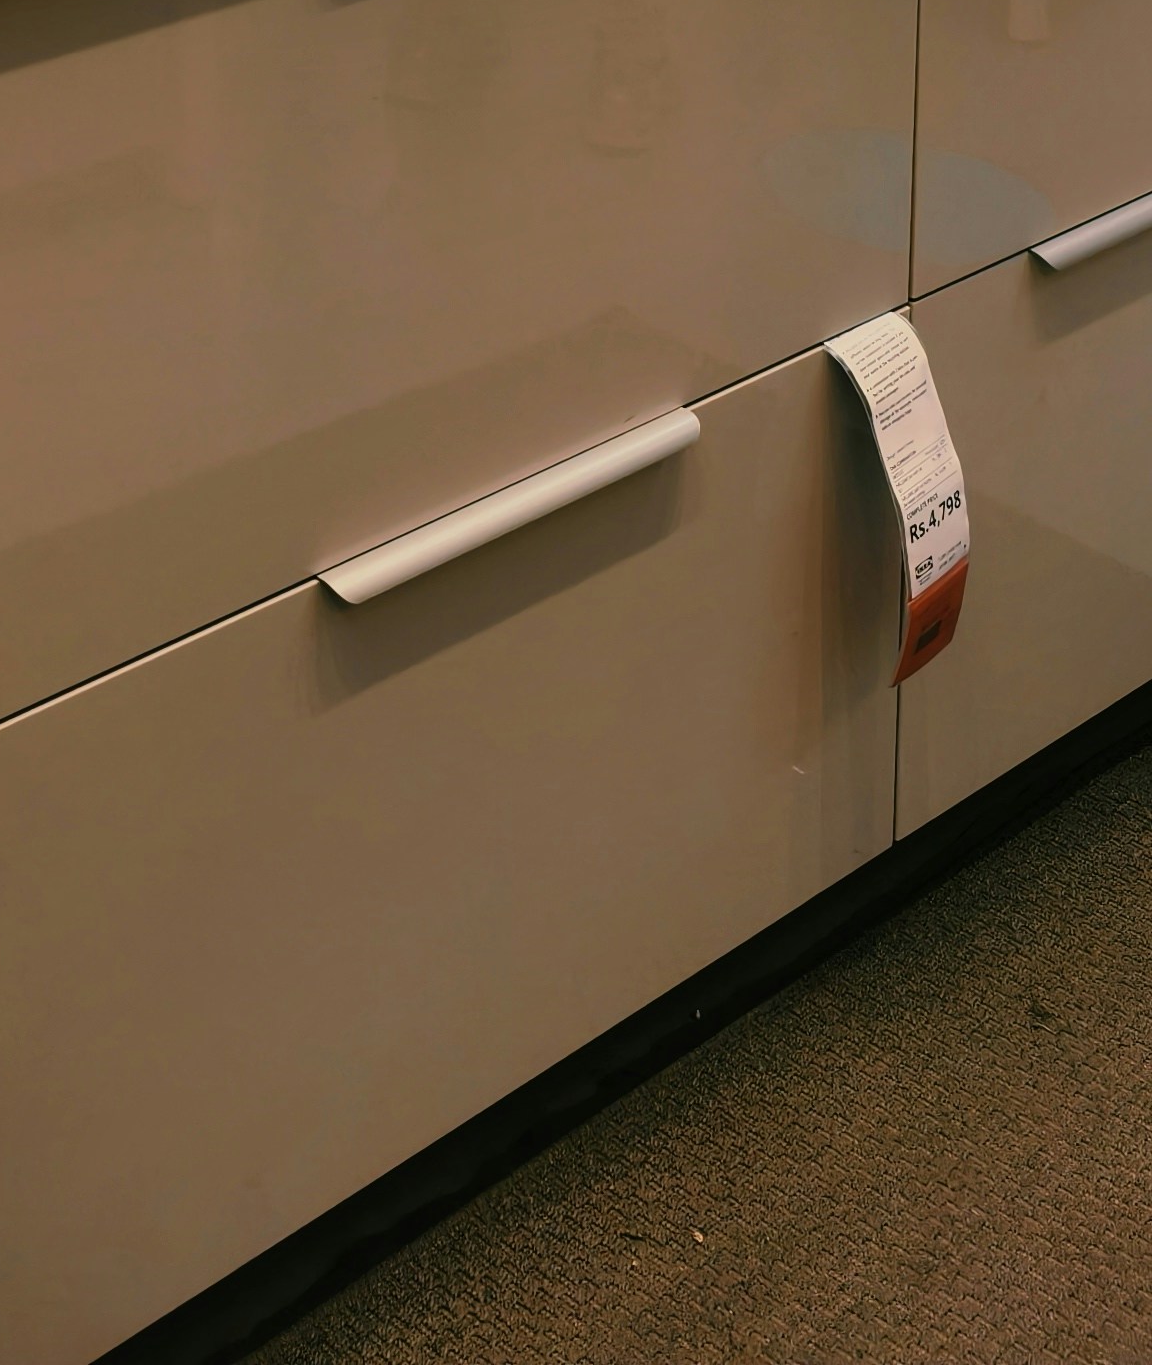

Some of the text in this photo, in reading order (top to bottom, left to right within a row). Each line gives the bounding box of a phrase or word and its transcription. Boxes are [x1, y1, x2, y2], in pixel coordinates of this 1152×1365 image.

[907, 493, 938, 520] COMPLETE PRICE
[910, 490, 961, 543] Rs.4,798
